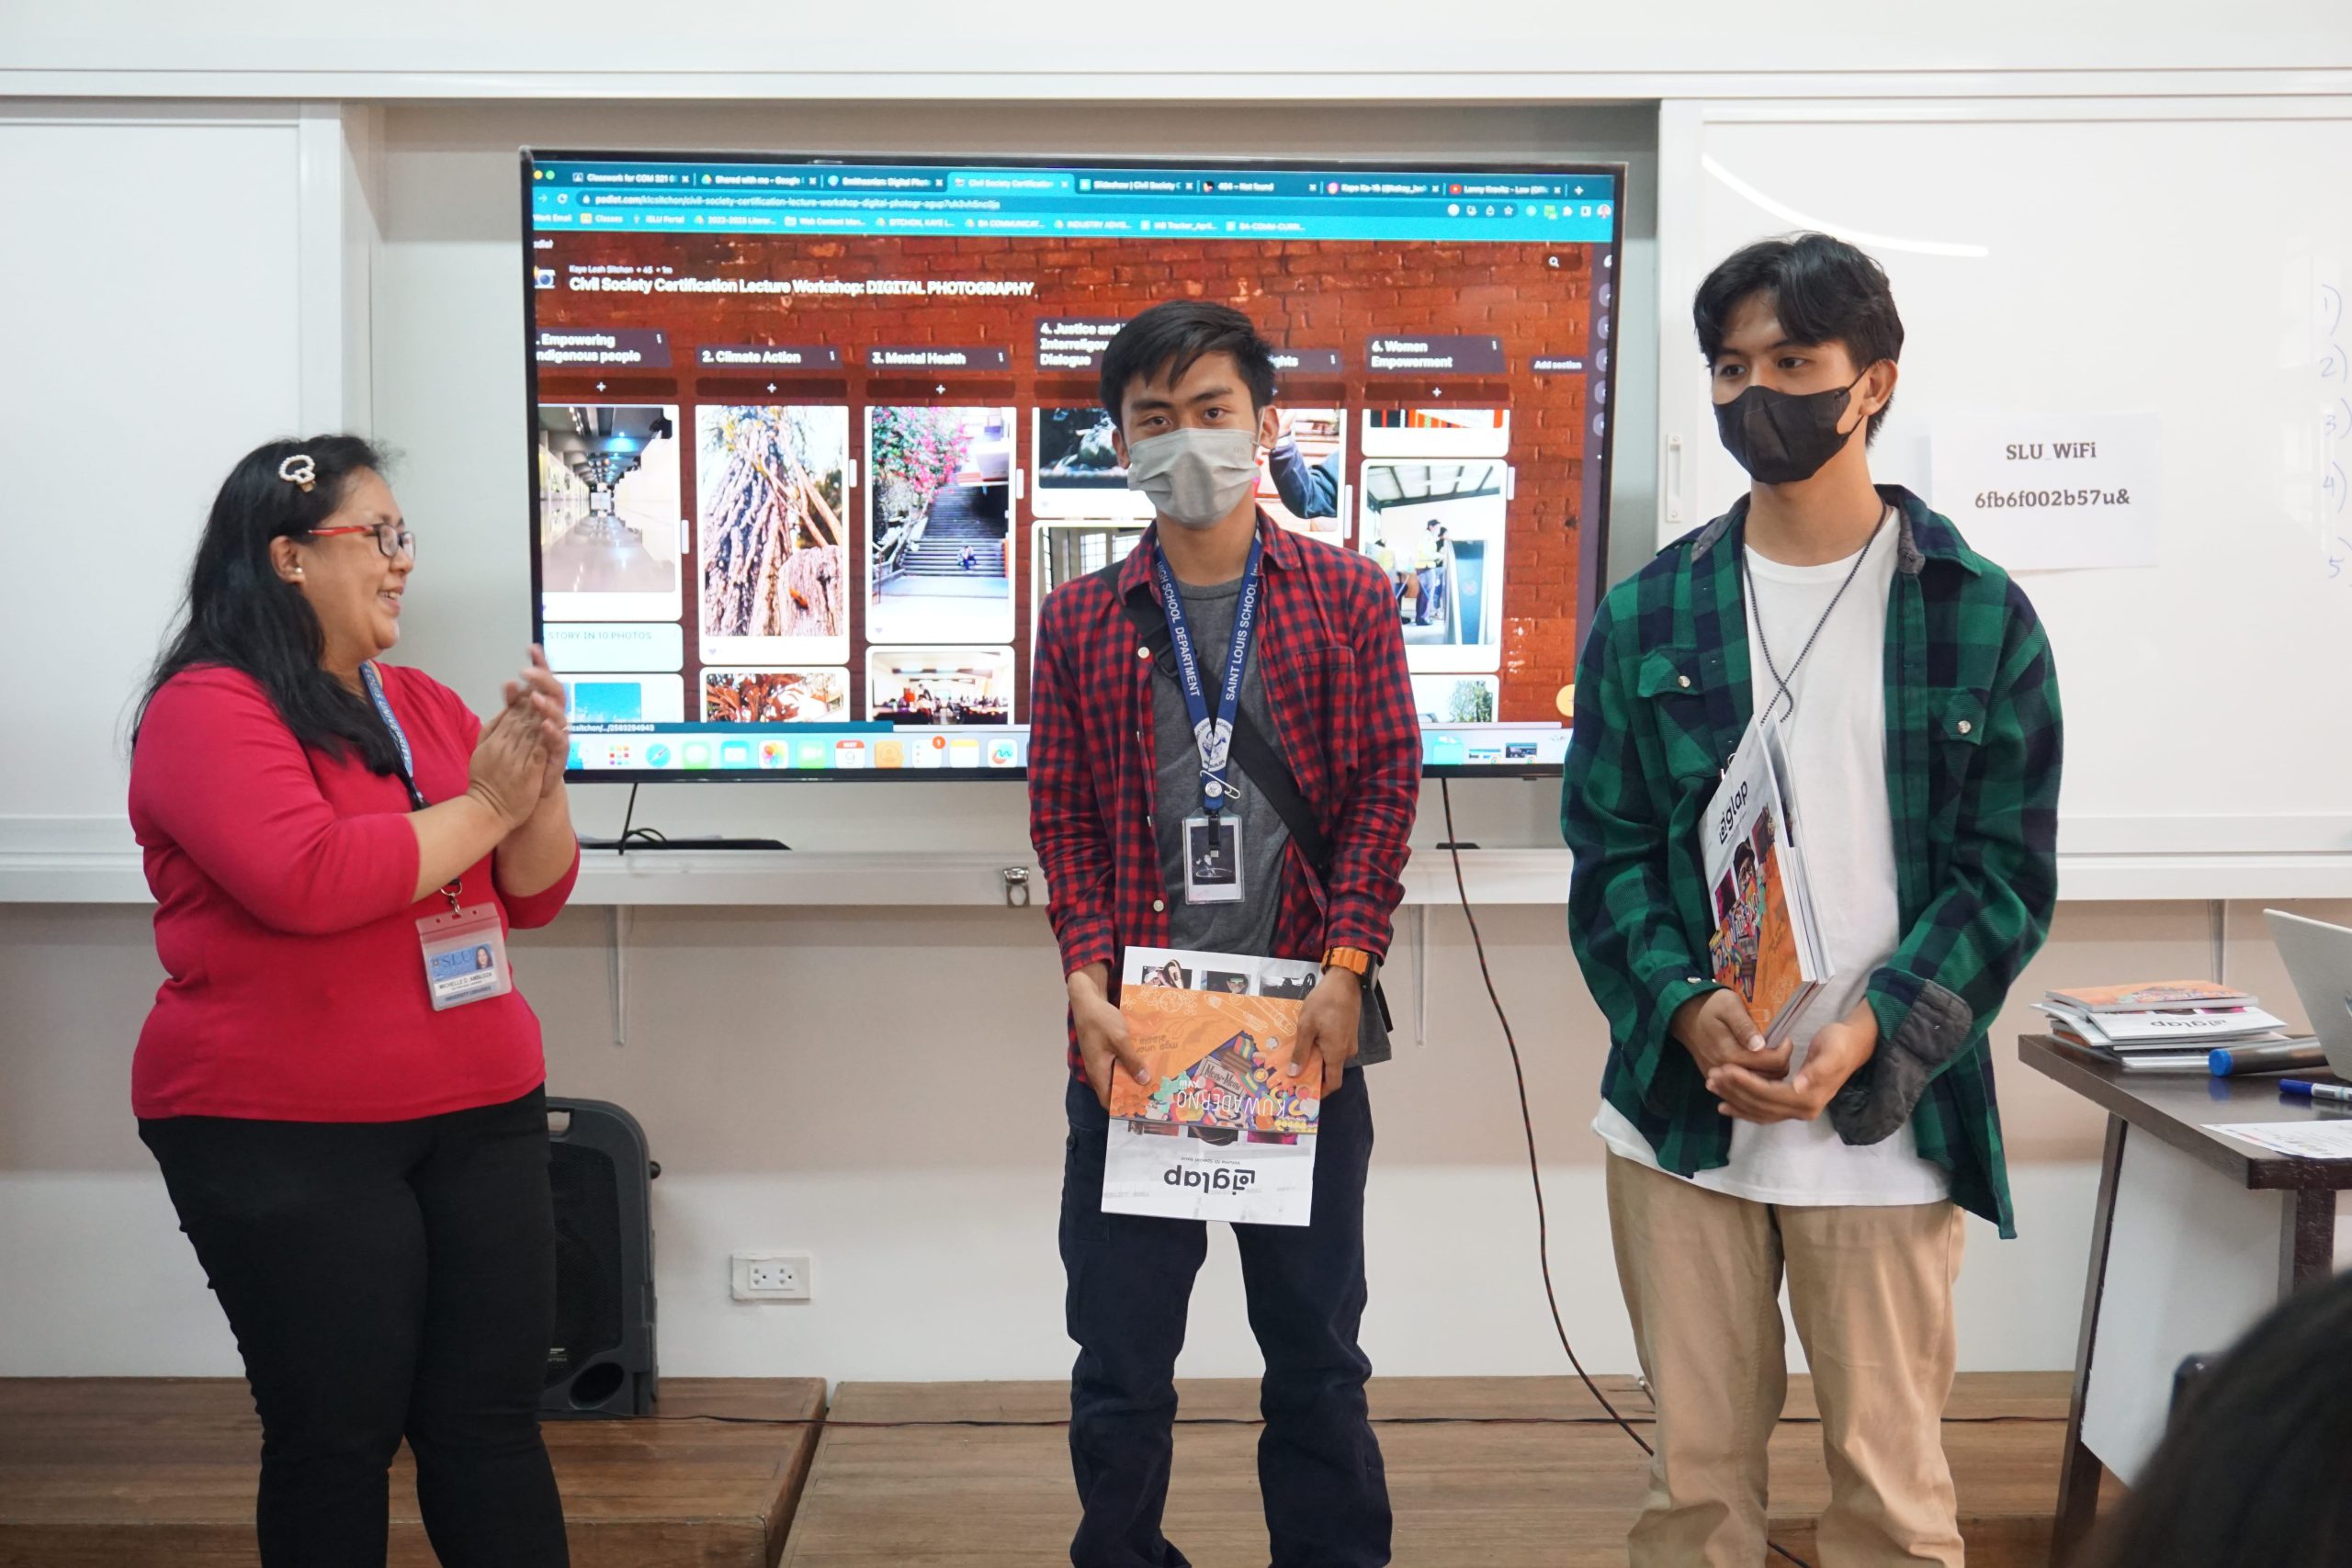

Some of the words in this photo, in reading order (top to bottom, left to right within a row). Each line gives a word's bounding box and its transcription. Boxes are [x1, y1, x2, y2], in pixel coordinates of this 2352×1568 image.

[570, 276, 599, 291] Civil
[601, 277, 653, 295] Society
[654, 277, 737, 293] Certification
[739, 279, 791, 294] Lecture
[792, 279, 865, 298] Workshop:
[866, 281, 925, 295] DIGITAL
[927, 281, 1035, 296] PHOTOGRAPHY
[1054, 322, 1096, 335] Justice
[1097, 323, 1120, 336] and
[541, 333, 616, 349] Empowering
[1384, 340, 1428, 353] Women
[601, 351, 641, 364] people
[715, 351, 760, 363] Climate
[763, 352, 801, 365] Action
[886, 351, 928, 365] Mental
[930, 352, 967, 365] Health
[1040, 353, 1091, 368] Dialogue
[1371, 355, 1453, 369] Empowerment
[1553, 361, 1582, 370] section
[1975, 489, 2130, 509] 6fb6f002b57u&
[1156, 560, 1169, 587] HIGH
[1161, 582, 1182, 624] SCHOOL
[1240, 582, 1259, 628] SCHOOL
[548, 632, 581, 640] STORY
[584, 632, 595, 640] IN
[599, 632, 608, 640] 10
[612, 632, 652, 640] PHOTOS
[1234, 630, 1248, 665] LOUIS
[1174, 626, 1200, 697] DEPARTMENT
[1226, 665, 1240, 701] SAINT
[1176, 1089, 1286, 1117] KUWADERNO
